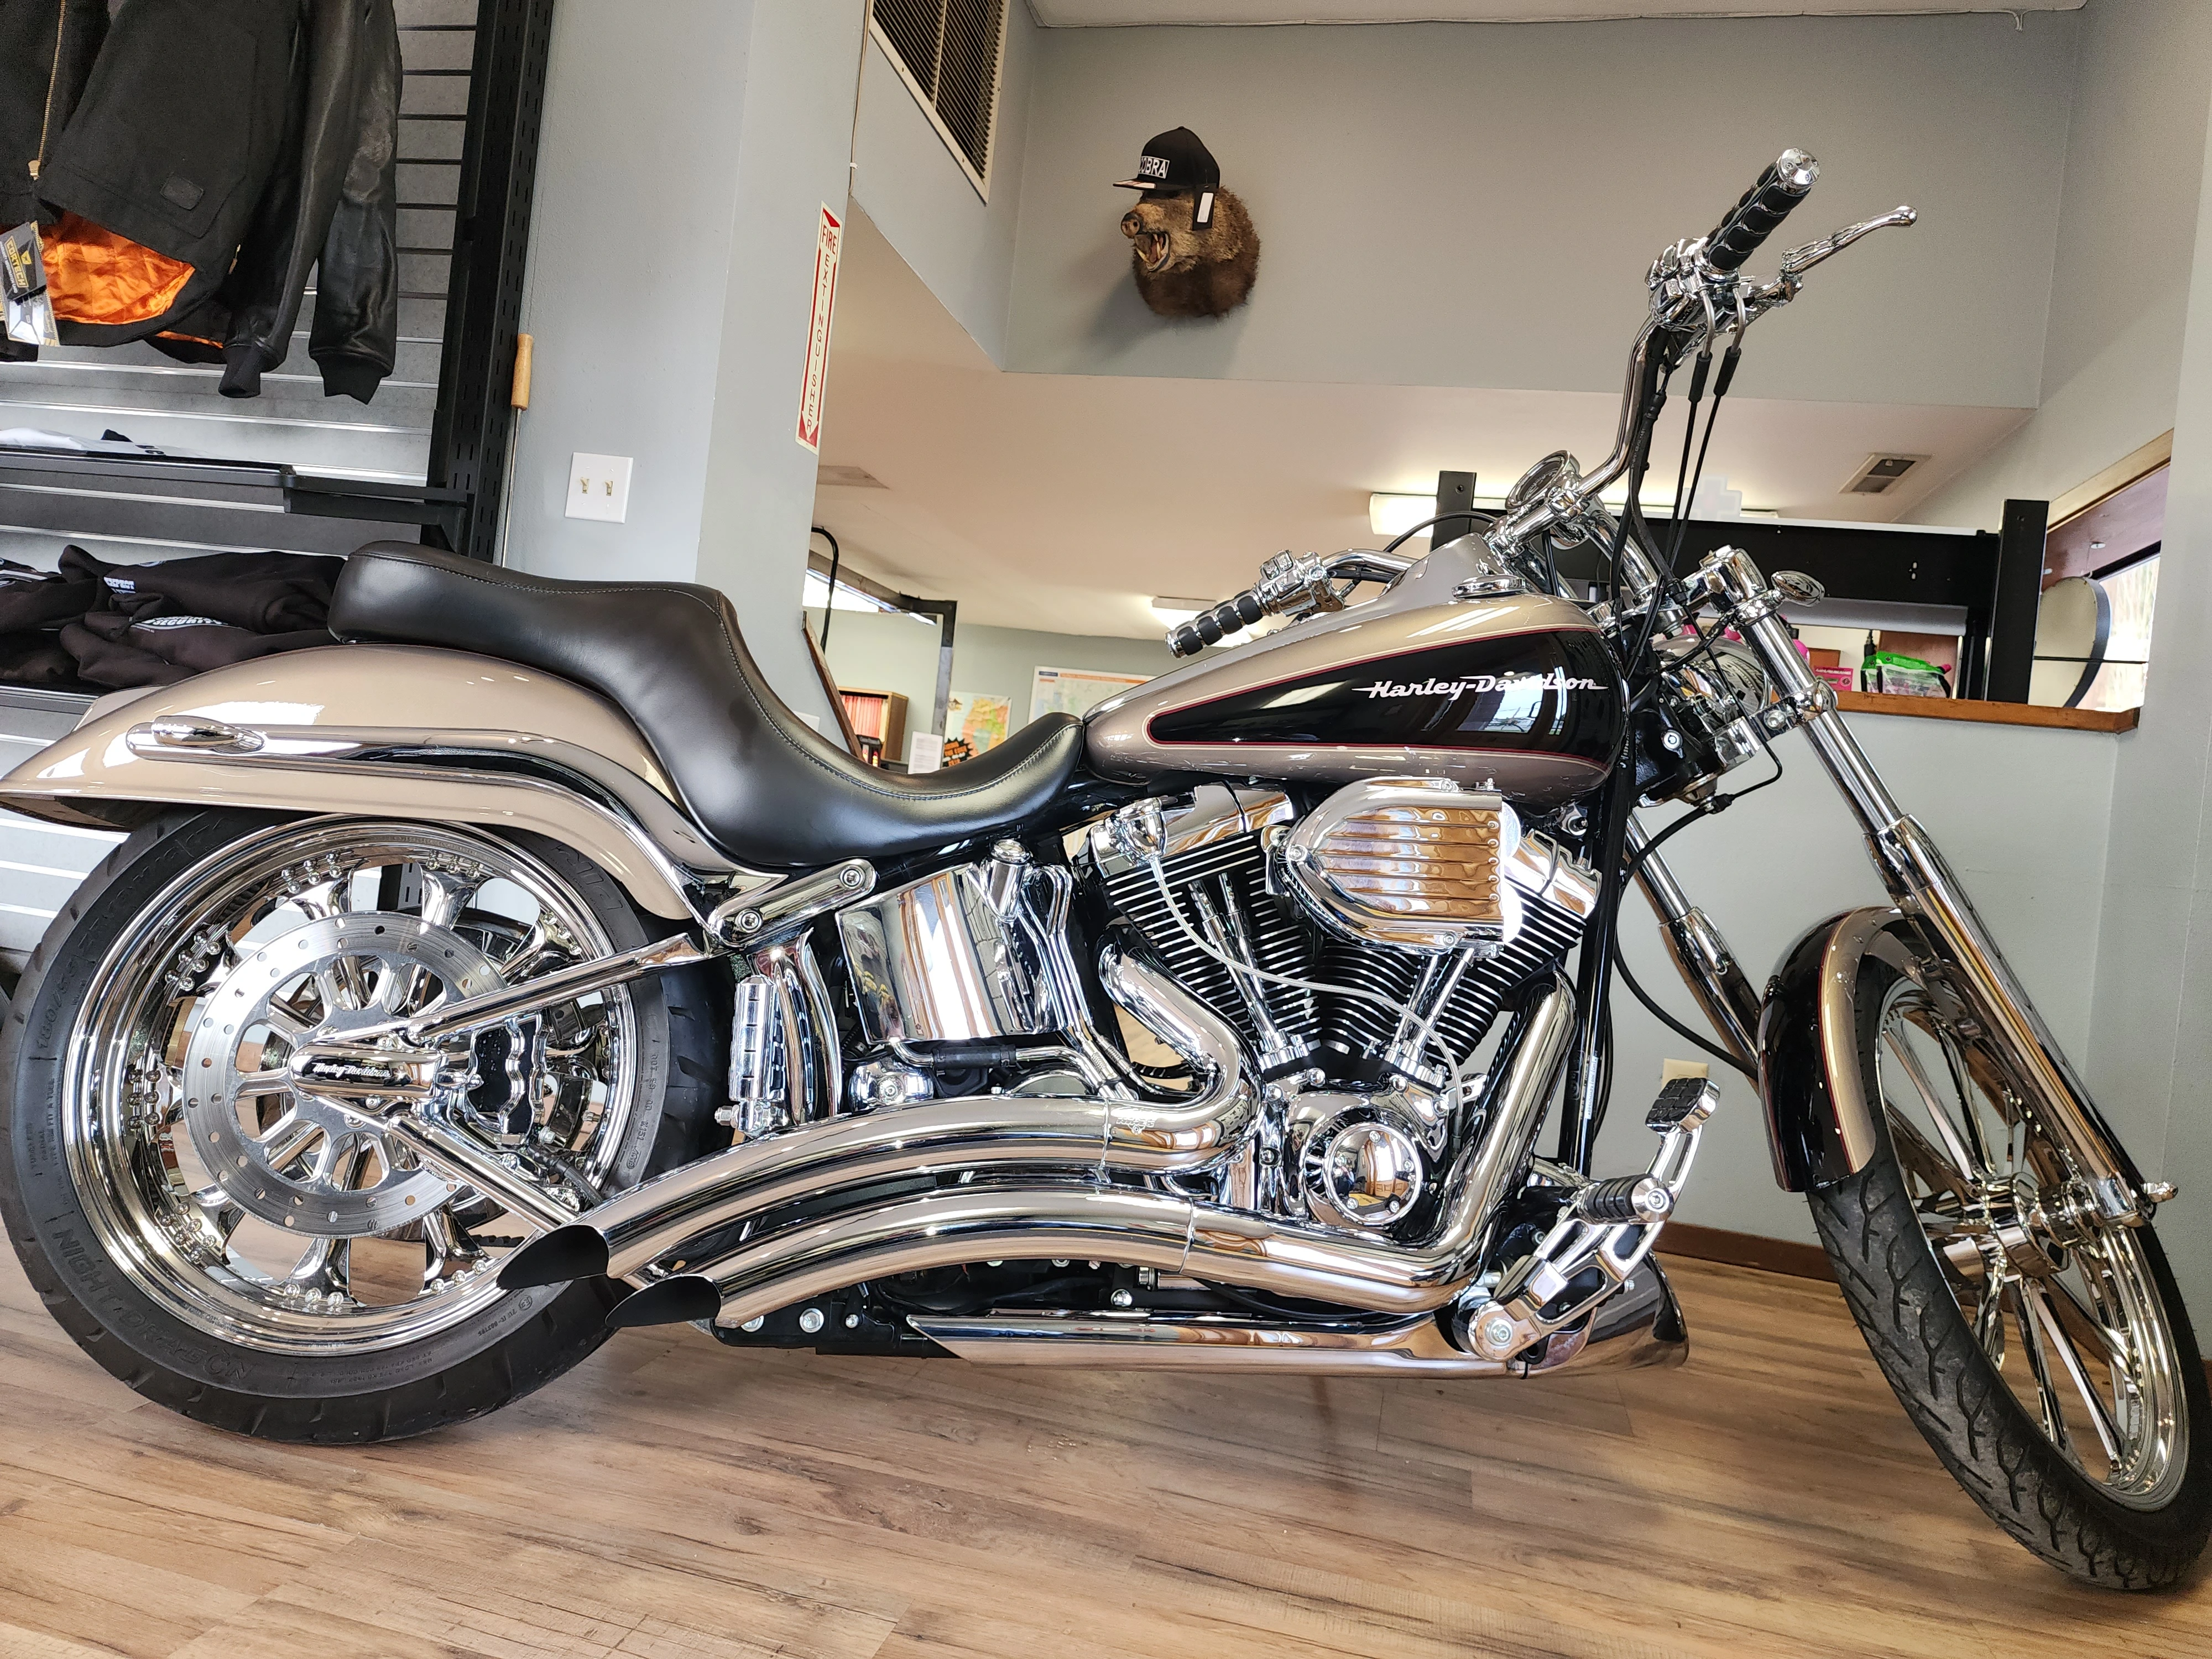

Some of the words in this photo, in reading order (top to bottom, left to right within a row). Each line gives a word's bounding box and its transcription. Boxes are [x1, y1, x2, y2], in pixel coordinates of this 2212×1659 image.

[822, 225, 837, 255] FIRE
[7, 240, 26, 285] CORTECH
[807, 254, 830, 433] EXTINGUISHER
[1352, 673, 1609, 700] Harley-Dadson
[312, 1062, 391, 1078] Harley-Davidson
